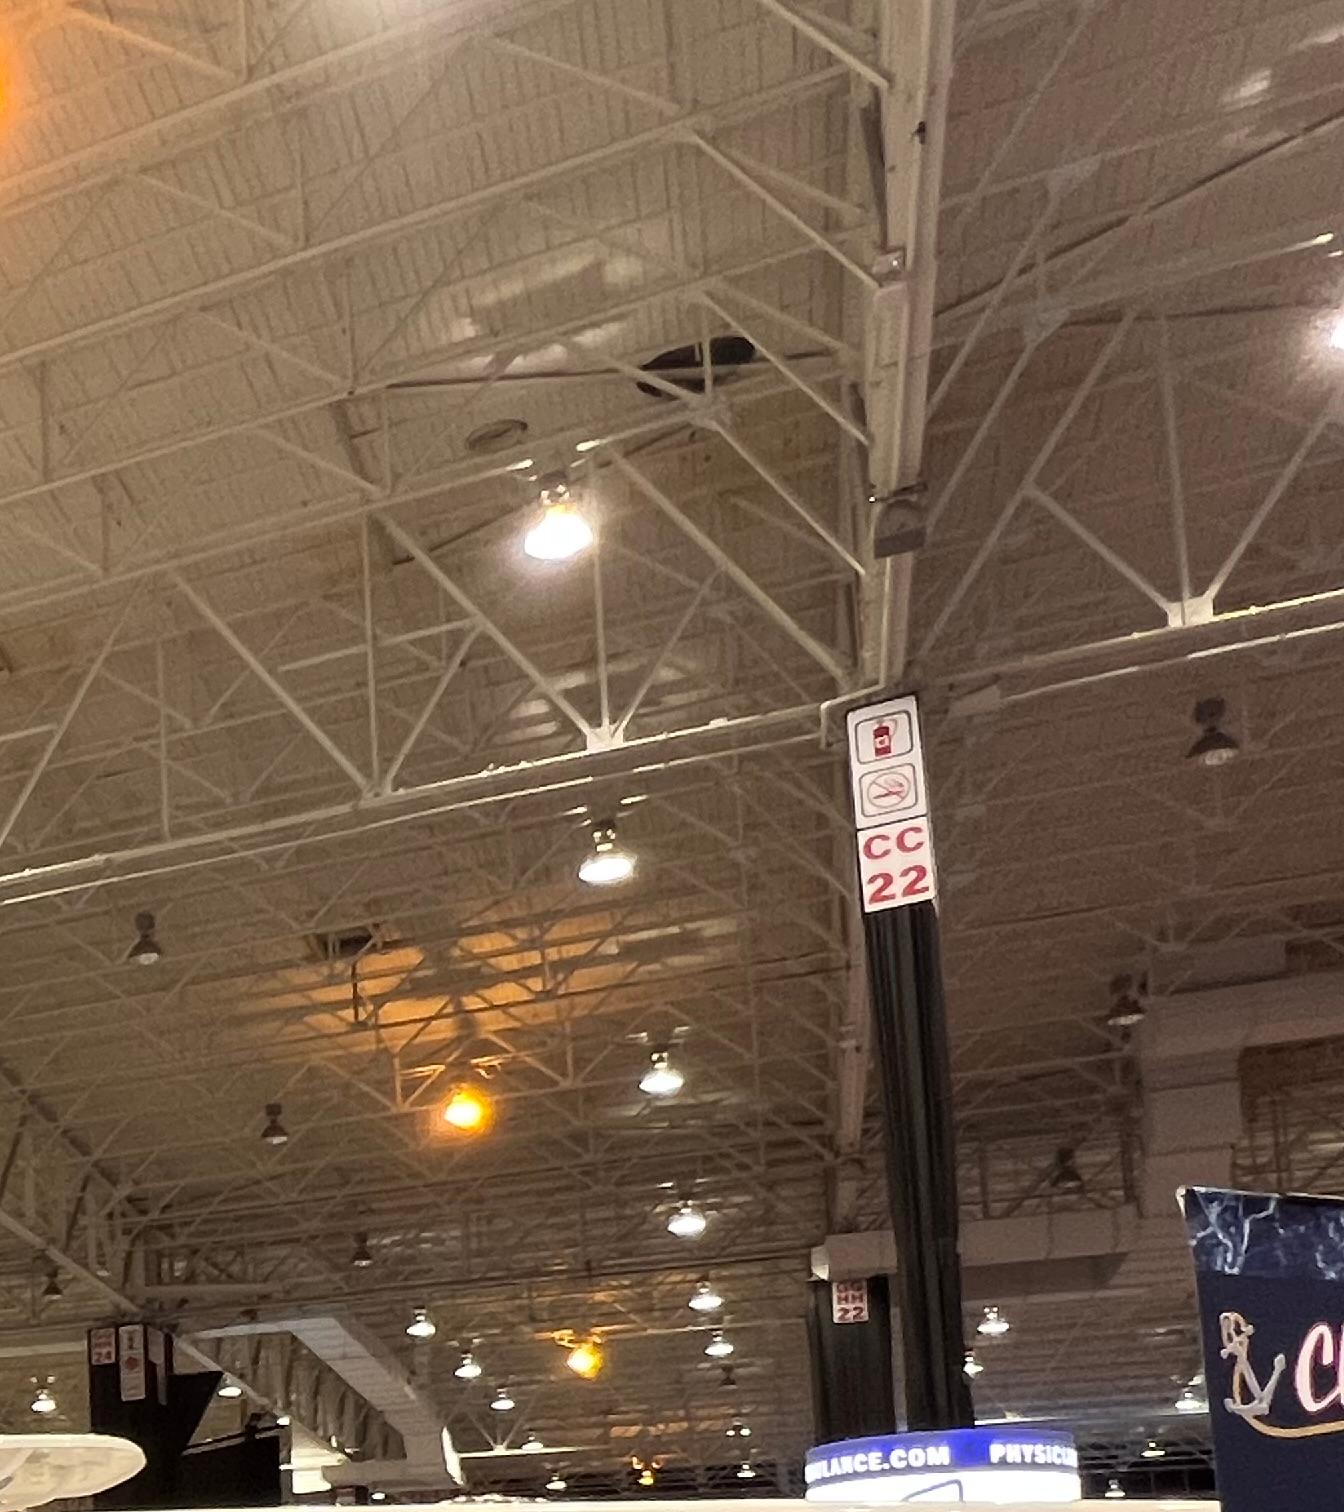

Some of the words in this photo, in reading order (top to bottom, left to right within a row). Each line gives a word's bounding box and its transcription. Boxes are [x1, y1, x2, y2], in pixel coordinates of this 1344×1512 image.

[862, 825, 925, 861] CC
[867, 863, 930, 905] 22
[837, 1306, 865, 1322] 22
